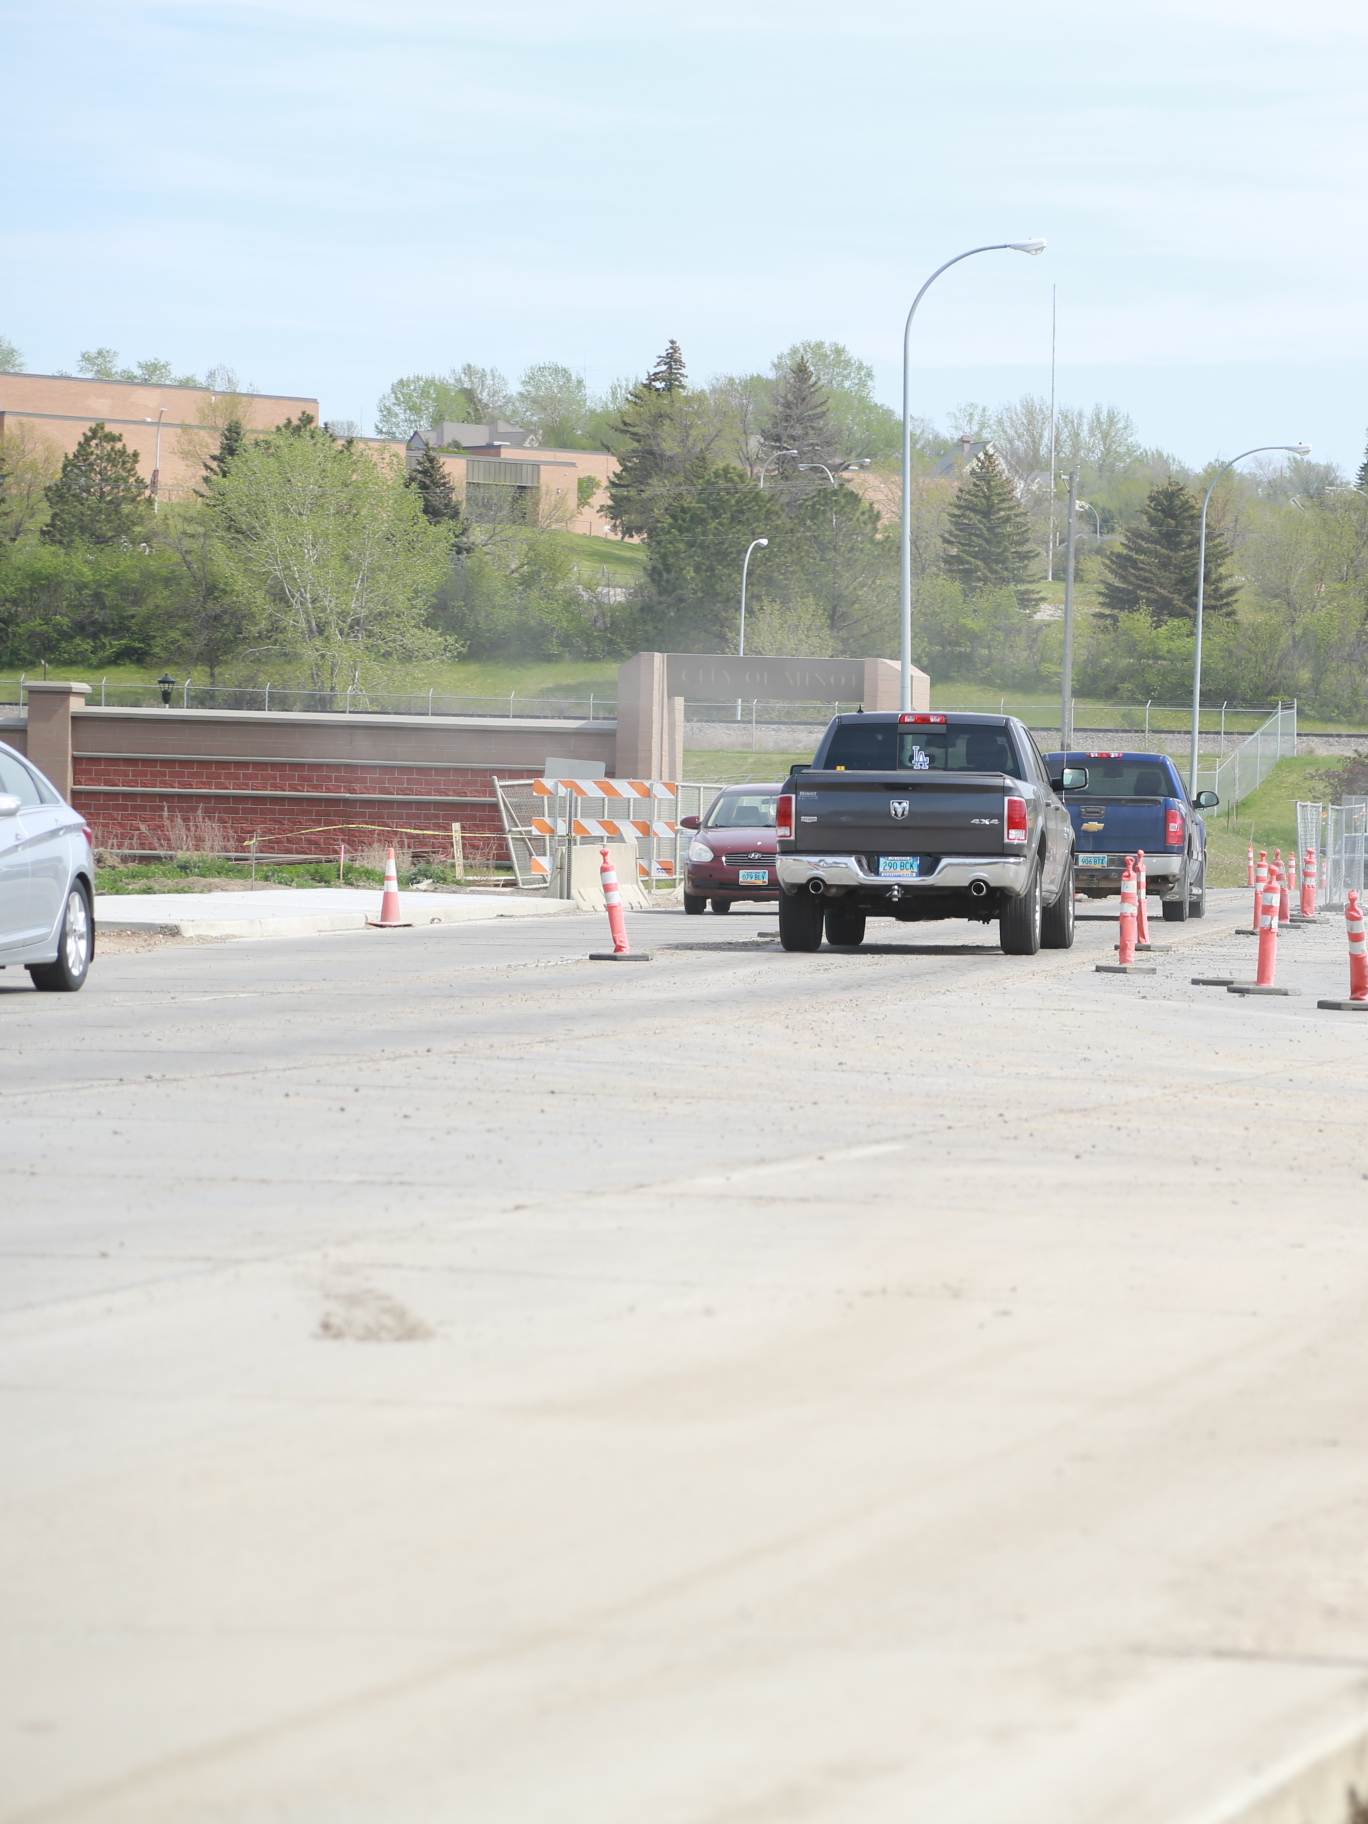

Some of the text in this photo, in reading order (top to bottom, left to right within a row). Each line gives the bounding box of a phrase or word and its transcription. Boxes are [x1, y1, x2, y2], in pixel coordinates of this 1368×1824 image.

[682, 669, 859, 688] CITY OF MINOT
[882, 861, 915, 871] 290 BCK
[1081, 858, 1105, 866] 906 BTX
